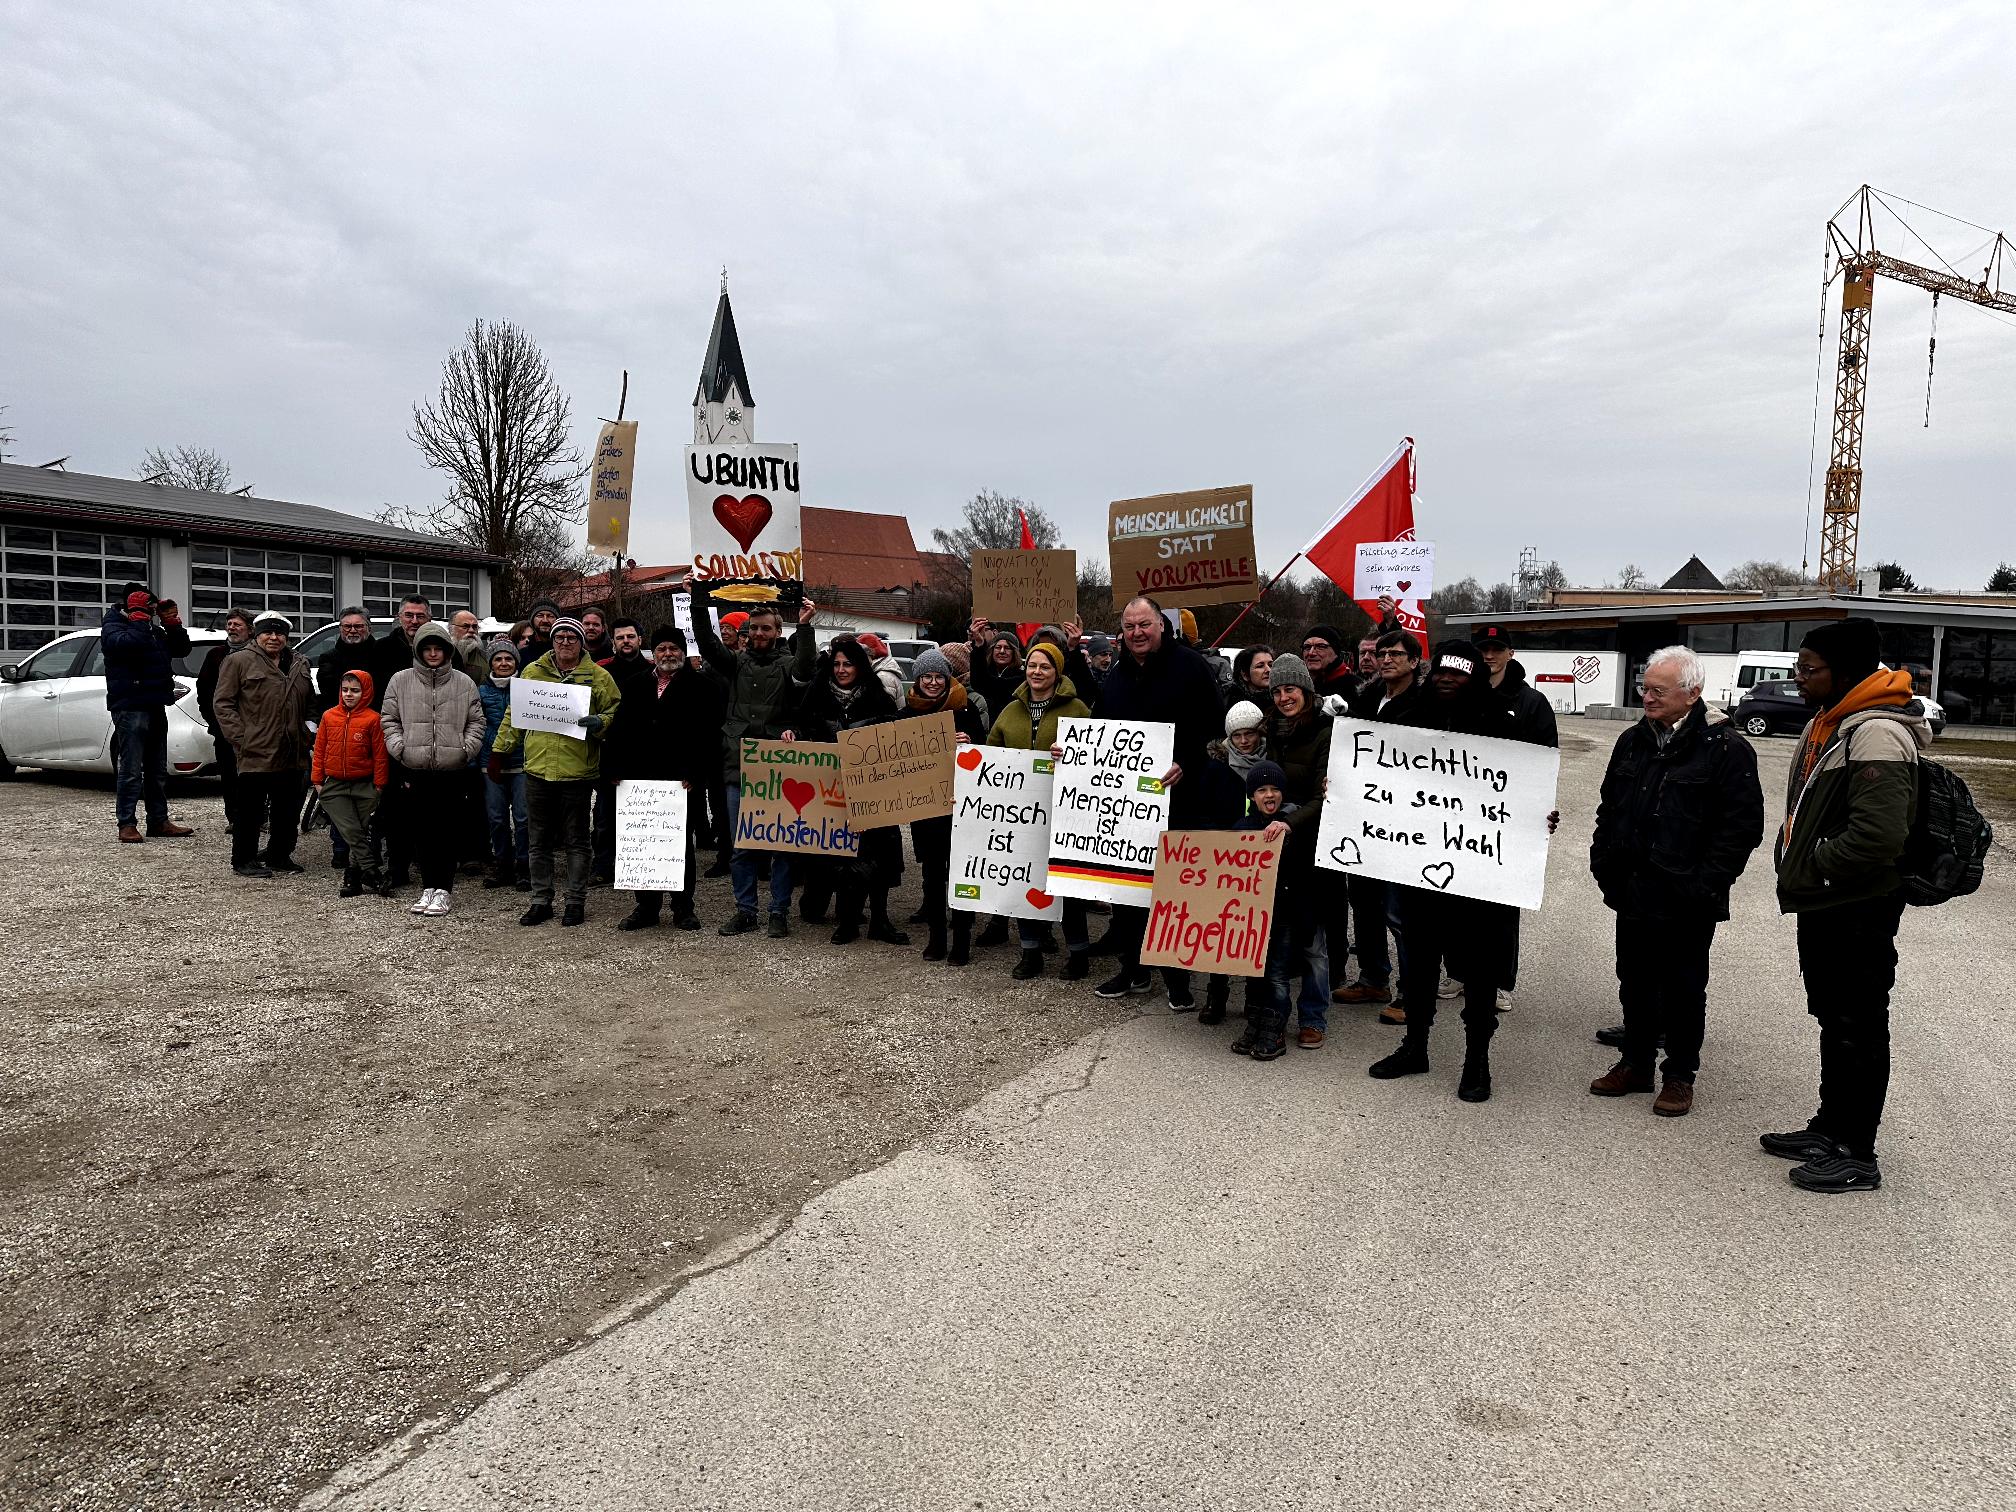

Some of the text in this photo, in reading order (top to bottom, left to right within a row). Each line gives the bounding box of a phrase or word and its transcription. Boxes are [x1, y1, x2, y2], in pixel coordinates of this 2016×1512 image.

[691, 452, 800, 493] UBUNTU
[1115, 500, 1248, 537] MENSCHLICHKEIT
[1157, 533, 1217, 559] STATT
[980, 554, 1050, 569] INNOVATION
[1136, 557, 1251, 590] VORURTEILE
[1365, 564, 1385, 573] sein
[981, 576, 1052, 590] INTEGRATION
[1016, 597, 1075, 612] MIGRATION
[1440, 654, 1474, 675] MARVEL
[532, 689, 548, 697] Wir
[743, 738, 841, 770] Zusamm
[847, 721, 950, 766] Solidarität
[1113, 728, 1146, 752] GG
[1061, 745, 1154, 773] Die Würde
[741, 769, 846, 801] halt Wü
[846, 768, 865, 788] mit
[977, 761, 1025, 790] Kein
[1090, 769, 1125, 789] des
[848, 796, 881, 819] immer
[884, 788, 904, 813] und
[960, 795, 1047, 825] Mensch
[1410, 790, 1464, 811] sein
[1480, 801, 1512, 824] ist
[1096, 813, 1120, 837] ist
[987, 828, 1015, 853] ist
[1054, 831, 1158, 865] unantastbar
[1162, 834, 1274, 870] Wie wäre
[1362, 820, 1503, 866] keine Wahl
[964, 855, 1032, 887] illegal
[1179, 867, 1263, 896] es mit
[1145, 898, 1269, 970] Mitgefühl
